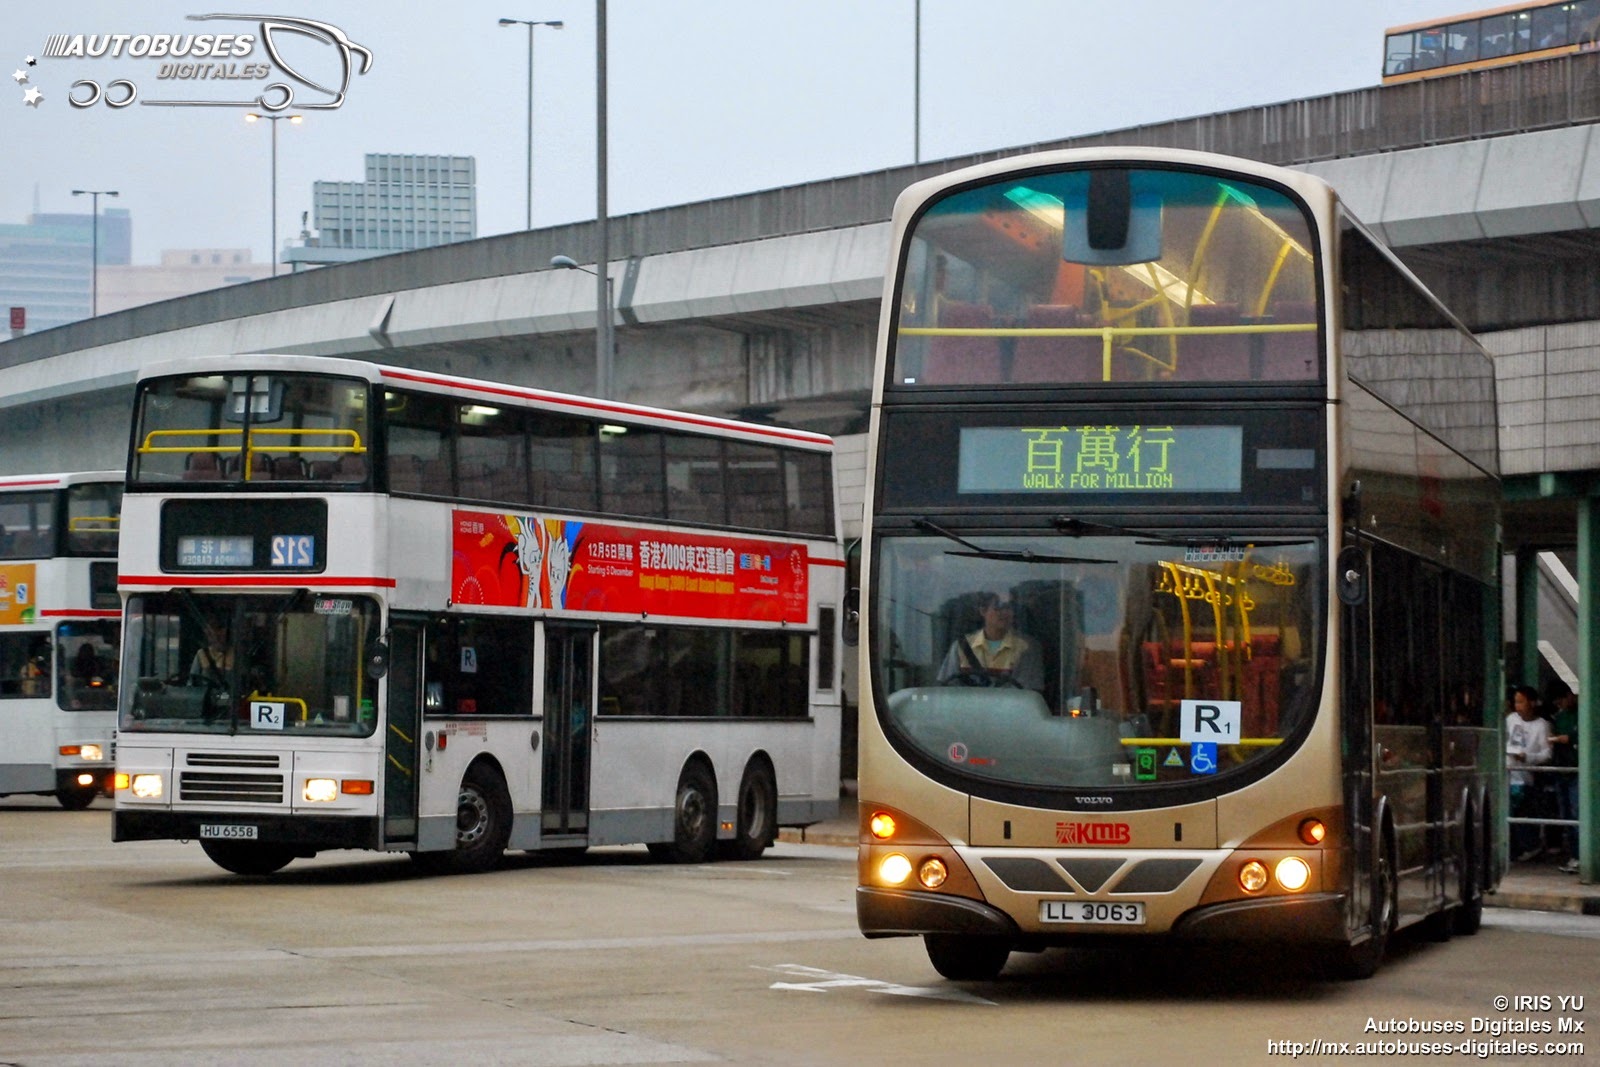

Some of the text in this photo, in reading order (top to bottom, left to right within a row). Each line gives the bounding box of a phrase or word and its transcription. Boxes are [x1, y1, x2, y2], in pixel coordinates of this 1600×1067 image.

[1021, 425, 1175, 472] 百萬行
[1023, 473, 1173, 488] WALK FOR MILLION
[588, 541, 633, 560] 12月5日開幕
[639, 541, 735, 575] 香港2009東亞運動會
[588, 564, 606, 577] Starting
[611, 566, 634, 577] December
[1075, 796, 1113, 804] VOLVO
[204, 825, 253, 837] HU 6558
[1076, 823, 1131, 845] KMB
[1047, 903, 1138, 921] LL 3063
